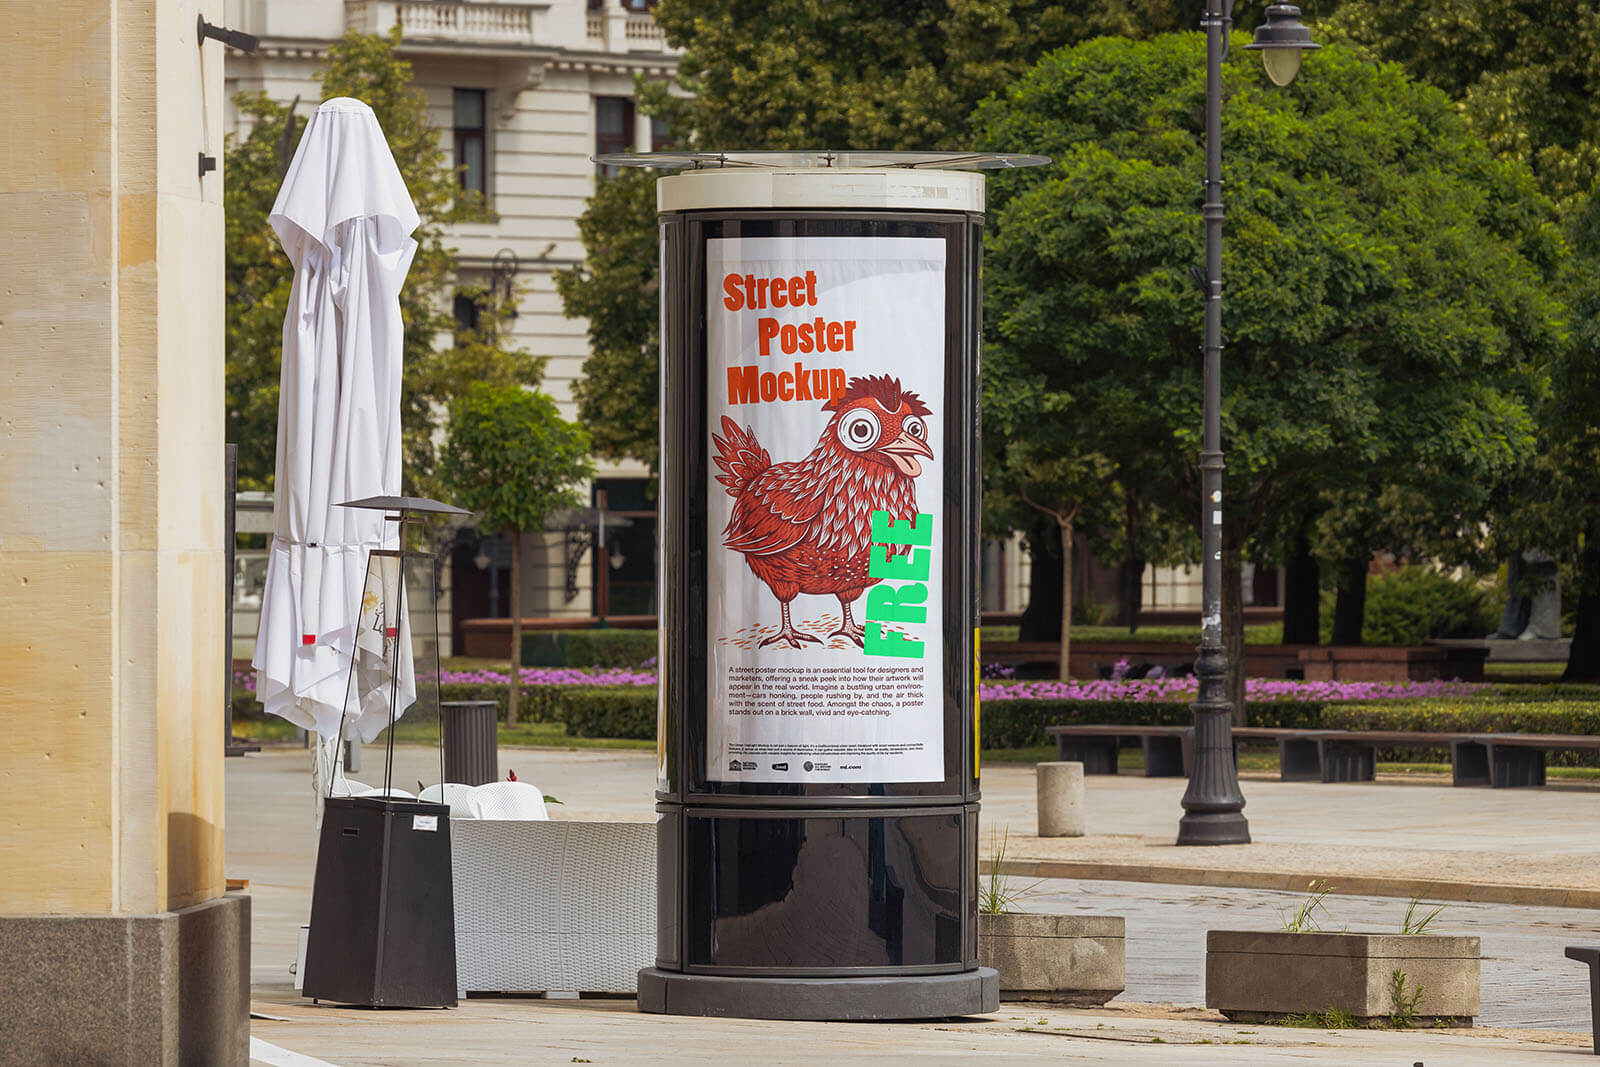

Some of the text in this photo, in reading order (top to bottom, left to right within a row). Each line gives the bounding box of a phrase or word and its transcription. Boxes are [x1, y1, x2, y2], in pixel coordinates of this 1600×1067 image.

[723, 270, 818, 312] Street
[758, 317, 857, 356] Poster
[727, 362, 846, 406] Mockup
[863, 510, 934, 659] FREE
[755, 666, 776, 674] poster
[778, 666, 804, 674] mockup
[877, 666, 910, 674] designers
[765, 675, 791, 683] offering
[820, 675, 837, 683] peek
[800, 692, 824, 700] people
[826, 692, 851, 700] rushing
[902, 700, 924, 708] poster
